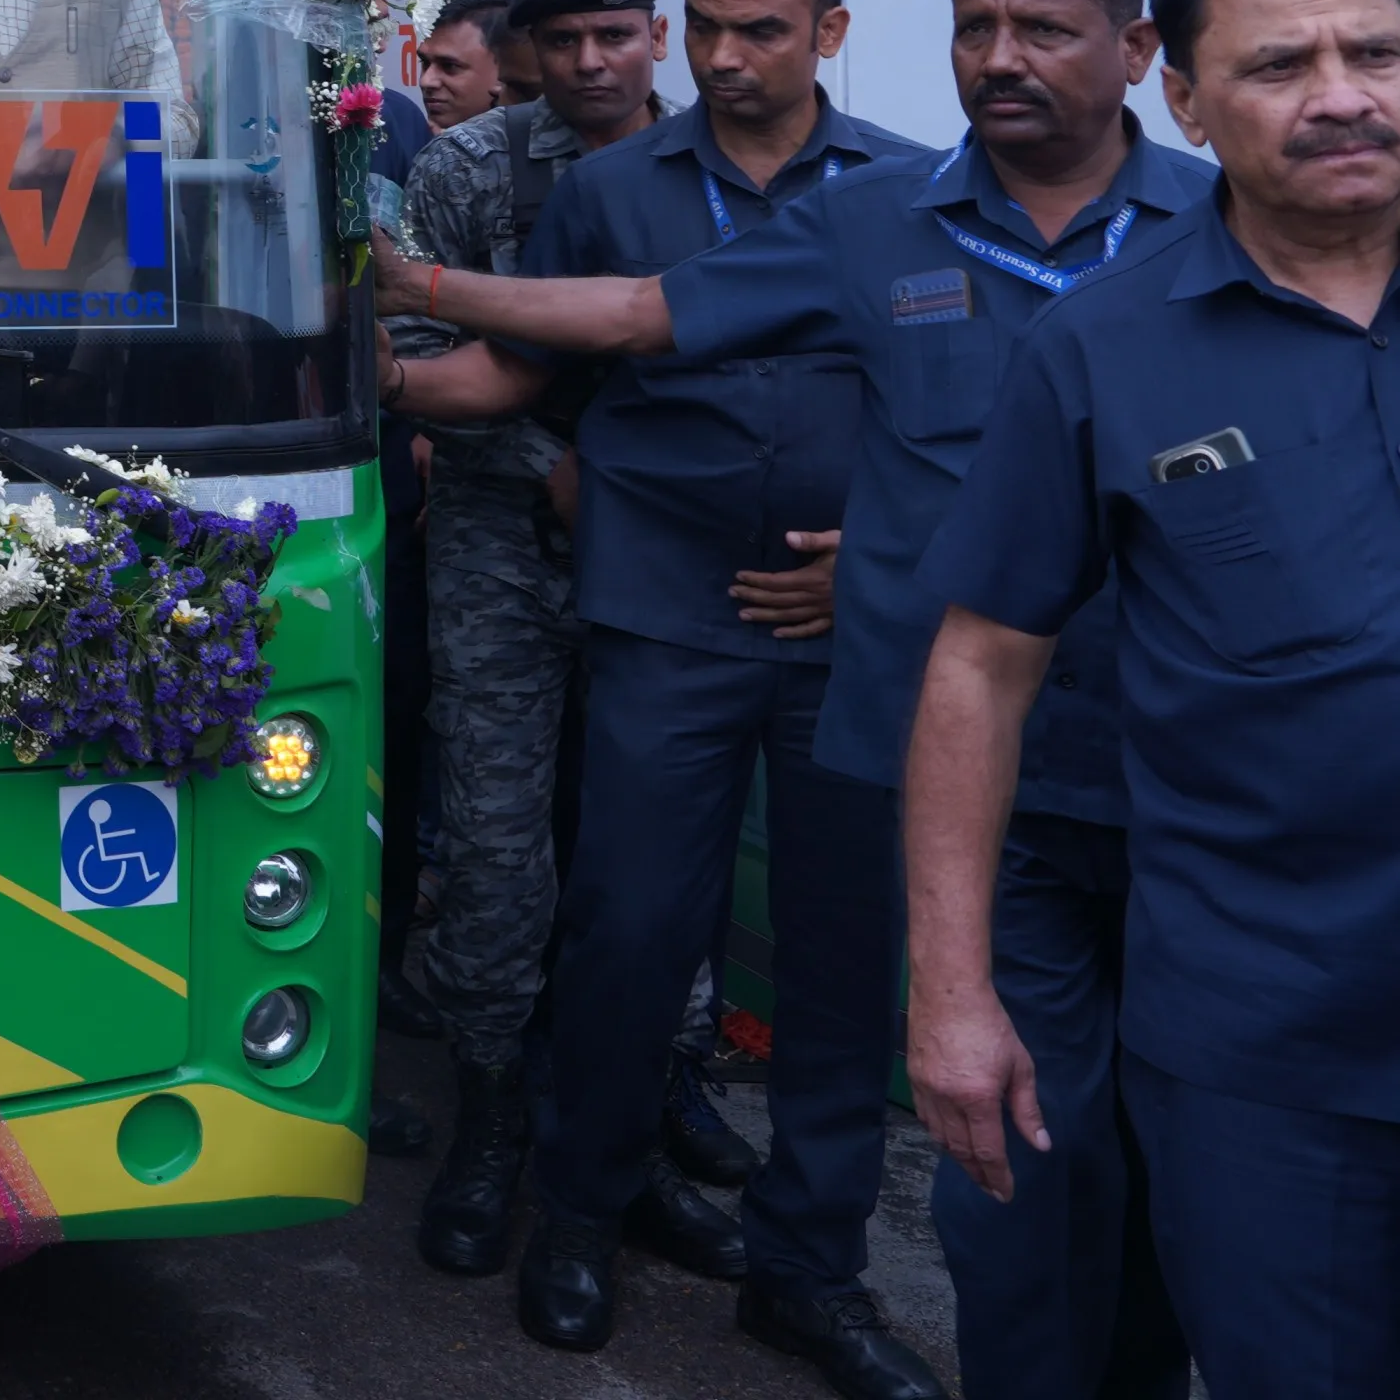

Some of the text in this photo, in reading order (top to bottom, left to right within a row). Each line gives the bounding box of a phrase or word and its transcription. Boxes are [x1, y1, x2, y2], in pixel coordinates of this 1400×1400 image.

[1112, 201, 1136, 236] (MHA
[956, 232, 987, 255] CRPF
[988, 246, 1040, 277] Security
[1038, 273, 1064, 289] VIP
